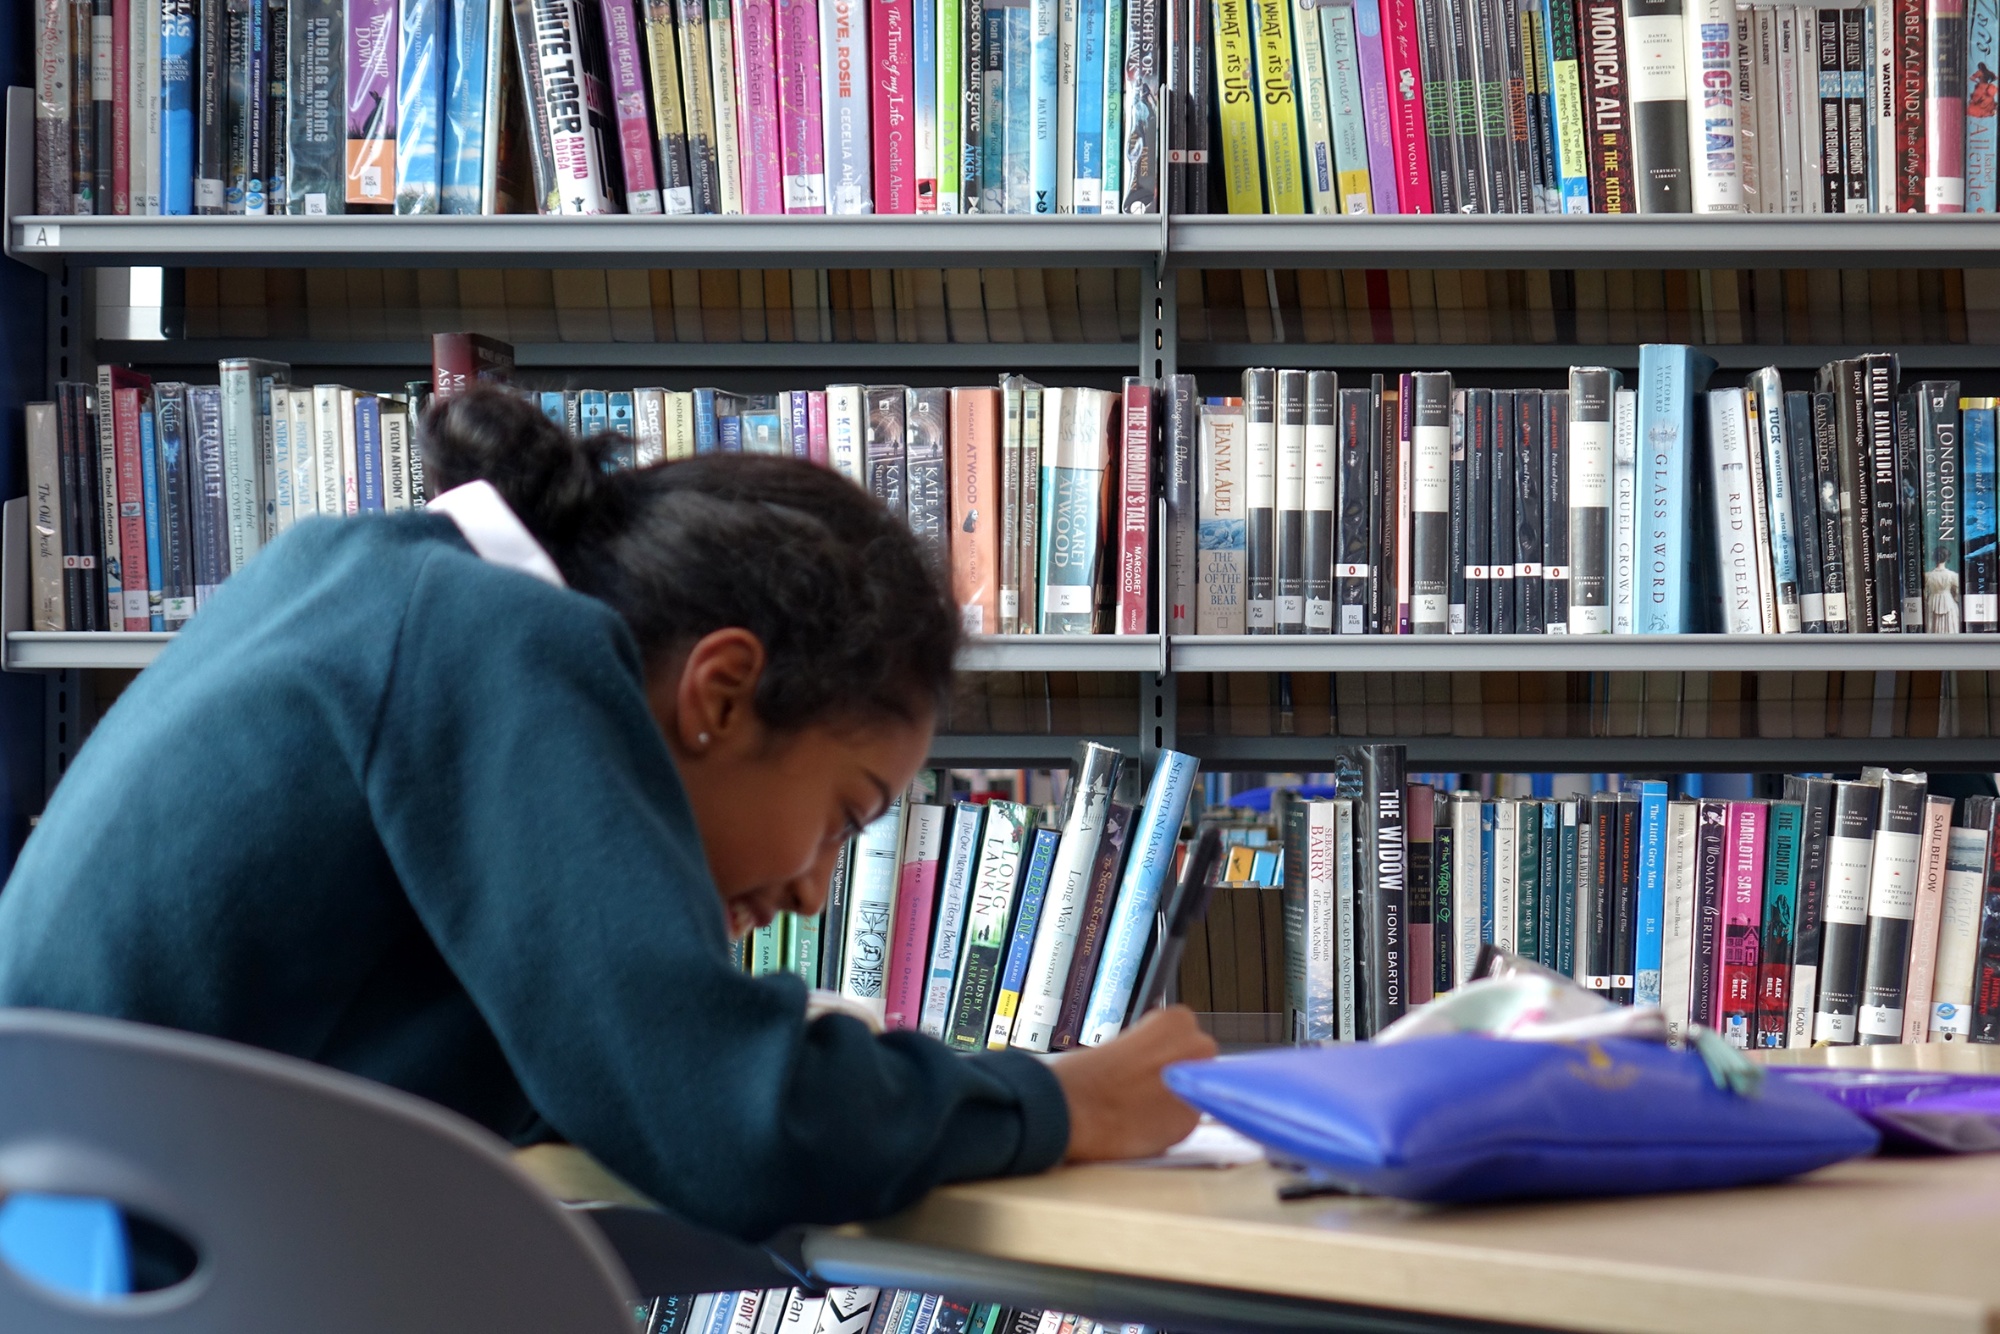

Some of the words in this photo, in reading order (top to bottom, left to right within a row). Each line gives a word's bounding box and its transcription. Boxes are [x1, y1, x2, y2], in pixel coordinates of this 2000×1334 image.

[613, 6, 629, 45] CHERRY
[888, 8, 900, 28] The
[990, 18, 1001, 38] Joan
[1306, 20, 1314, 37] The
[315, 18, 329, 84] DOUGLAS
[355, 27, 372, 68] DOWN
[370, 14, 389, 78] WATERSHIP
[888, 27, 901, 62] Time
[990, 41, 1001, 66] Aiken
[1305, 39, 1320, 72] Time
[1591, 7, 1618, 88] MONICA
[618, 49, 635, 87] HEAVEN
[882, 60, 899, 73] of
[1701, 23, 1732, 109] BRICK
[882, 76, 898, 94] my
[1266, 79, 1291, 104] US
[1310, 77, 1322, 123] Keeper
[1905, 47, 1919, 121] ALLENDE
[315, 90, 329, 142] ADAMS
[887, 95, 903, 126] Life
[966, 92, 981, 132] grave
[990, 99, 998, 134] Shoulder
[1404, 104, 1412, 138] LITTLE
[1596, 97, 1621, 130] ALI
[555, 138, 570, 170] ADIGA
[889, 132, 901, 172] Cecelia
[1317, 144, 1325, 164] Mitch
[1603, 133, 1617, 145] IN
[1908, 147, 1918, 159] of
[570, 136, 588, 180] ARAVIND
[965, 143, 974, 181] AIKEN
[1407, 143, 1418, 185] WOMEN
[1604, 150, 1618, 171] THE
[1904, 158, 1918, 173] My
[1968, 120, 1989, 201] Allende
[1984, 153, 1995, 183] Isabel
[890, 175, 902, 209] Ahern
[1319, 166, 1328, 190] Albom
[1907, 175, 1919, 195] Soul
[36, 227, 48, 246] A
[100, 373, 109, 387] THE
[1656, 365, 1664, 413] AVEYARD
[1663, 365, 1672, 413] VICTORIA
[1853, 371, 1862, 394] Beryl
[1872, 368, 1890, 403] BERYL
[100, 390, 112, 441] SCAVENGER'S
[159, 397, 180, 432] Knife
[1128, 406, 1147, 428] THE
[1769, 408, 1781, 444] TUCK
[1856, 399, 1865, 447] Bainbridge
[103, 444, 112, 460] TALE
[390, 421, 401, 453] EVELYN
[1210, 422, 1234, 459] JEAN
[1874, 411, 1892, 484] BAINBRIDGE
[967, 443, 977, 504] ATWOOD
[1127, 430, 1147, 503] HANDMAID'S
[1858, 453, 1865, 466] An
[1925, 447, 1935, 465] JO
[104, 467, 112, 498] Rachel
[391, 456, 403, 499] ANTHONY
[1654, 454, 1667, 518] GLASS
[1774, 450, 1784, 498] everlasting
[1857, 469, 1867, 505] Awfully
[1937, 423, 1955, 540] LONGBOURN
[1215, 478, 1234, 516] AUEL
[1619, 478, 1630, 535] CRUEL
[1926, 471, 1936, 516] BAKER
[107, 502, 115, 545] Anderson
[1054, 476, 1071, 568] ATWOOD
[1071, 477, 1086, 570] MARGARET
[1126, 506, 1146, 531] TALE
[1729, 493, 1741, 530] RED
[1860, 508, 1868, 523] Big
[1213, 552, 1234, 563] THE
[1862, 525, 1871, 572] Adventure
[1125, 552, 1133, 592] ATWOOD
[1133, 546, 1142, 595] MARGARET
[1204, 574, 1218, 584] OF
[1220, 574, 1241, 584] THE
[1208, 563, 1238, 573] CLAN
[1618, 543, 1629, 605] CROWN
[1653, 531, 1666, 604] SWORD
[1732, 543, 1749, 610] QUEEN
[1209, 585, 1237, 594] CAVE
[1210, 595, 1238, 605] BEAR
[1865, 578, 1873, 626] Duckworth
[1155, 761, 1182, 829] SEBASTIAN
[1379, 789, 1400, 818] THE
[1649, 804, 1659, 820] The
[919, 818, 929, 846] Julian
[1648, 822, 1657, 845] Little
[1777, 812, 1793, 831] THE
[1812, 806, 1822, 838] JULIA
[1932, 814, 1944, 844] SAUL
[1142, 831, 1164, 875] BARRY
[1311, 825, 1323, 883] BARRY
[1379, 825, 1402, 891] WIDOW
[1647, 848, 1657, 869] Grey
[1738, 812, 1755, 871] CHARLOTTE
[1810, 844, 1820, 870] BELL
[915, 851, 925, 883] Barnes
[975, 838, 1004, 915] LANKIN
[1028, 843, 1052, 895] PETER
[1774, 835, 1792, 885] HAUNTING
[1927, 846, 1941, 892] BELLOW
[992, 849, 1018, 909] LONG
[1061, 870, 1081, 902] Long
[1313, 889, 1321, 898] of
[1647, 871, 1656, 888] Men
[1736, 876, 1752, 903] SAYS
[1130, 887, 1148, 912] The
[1313, 900, 1321, 923] Eneas
[1323, 889, 1331, 906] The
[1806, 880, 1817, 930] massive
[907, 897, 920, 947] Something
[1018, 902, 1038, 934] PAN
[1054, 905, 1073, 931] Way
[1118, 915, 1139, 953] Secret
[1322, 909, 1331, 961] Whereabouts
[1387, 905, 1397, 945] FIONA
[906, 952, 913, 961] to
[1312, 926, 1321, 961] McNulty
[900, 967, 912, 1005] Declare
[959, 953, 980, 1026] BARRACLOUGH
[973, 968, 989, 1011] LINDSEY
[1101, 957, 1130, 1014] Scripture
[1388, 951, 1398, 1005] BARTON
[1731, 979, 1739, 998] BELL
[1766, 977, 1774, 996] BELL
[1774, 977, 1782, 998] ALEX
[1795, 1007, 1806, 1035] PICADOR
